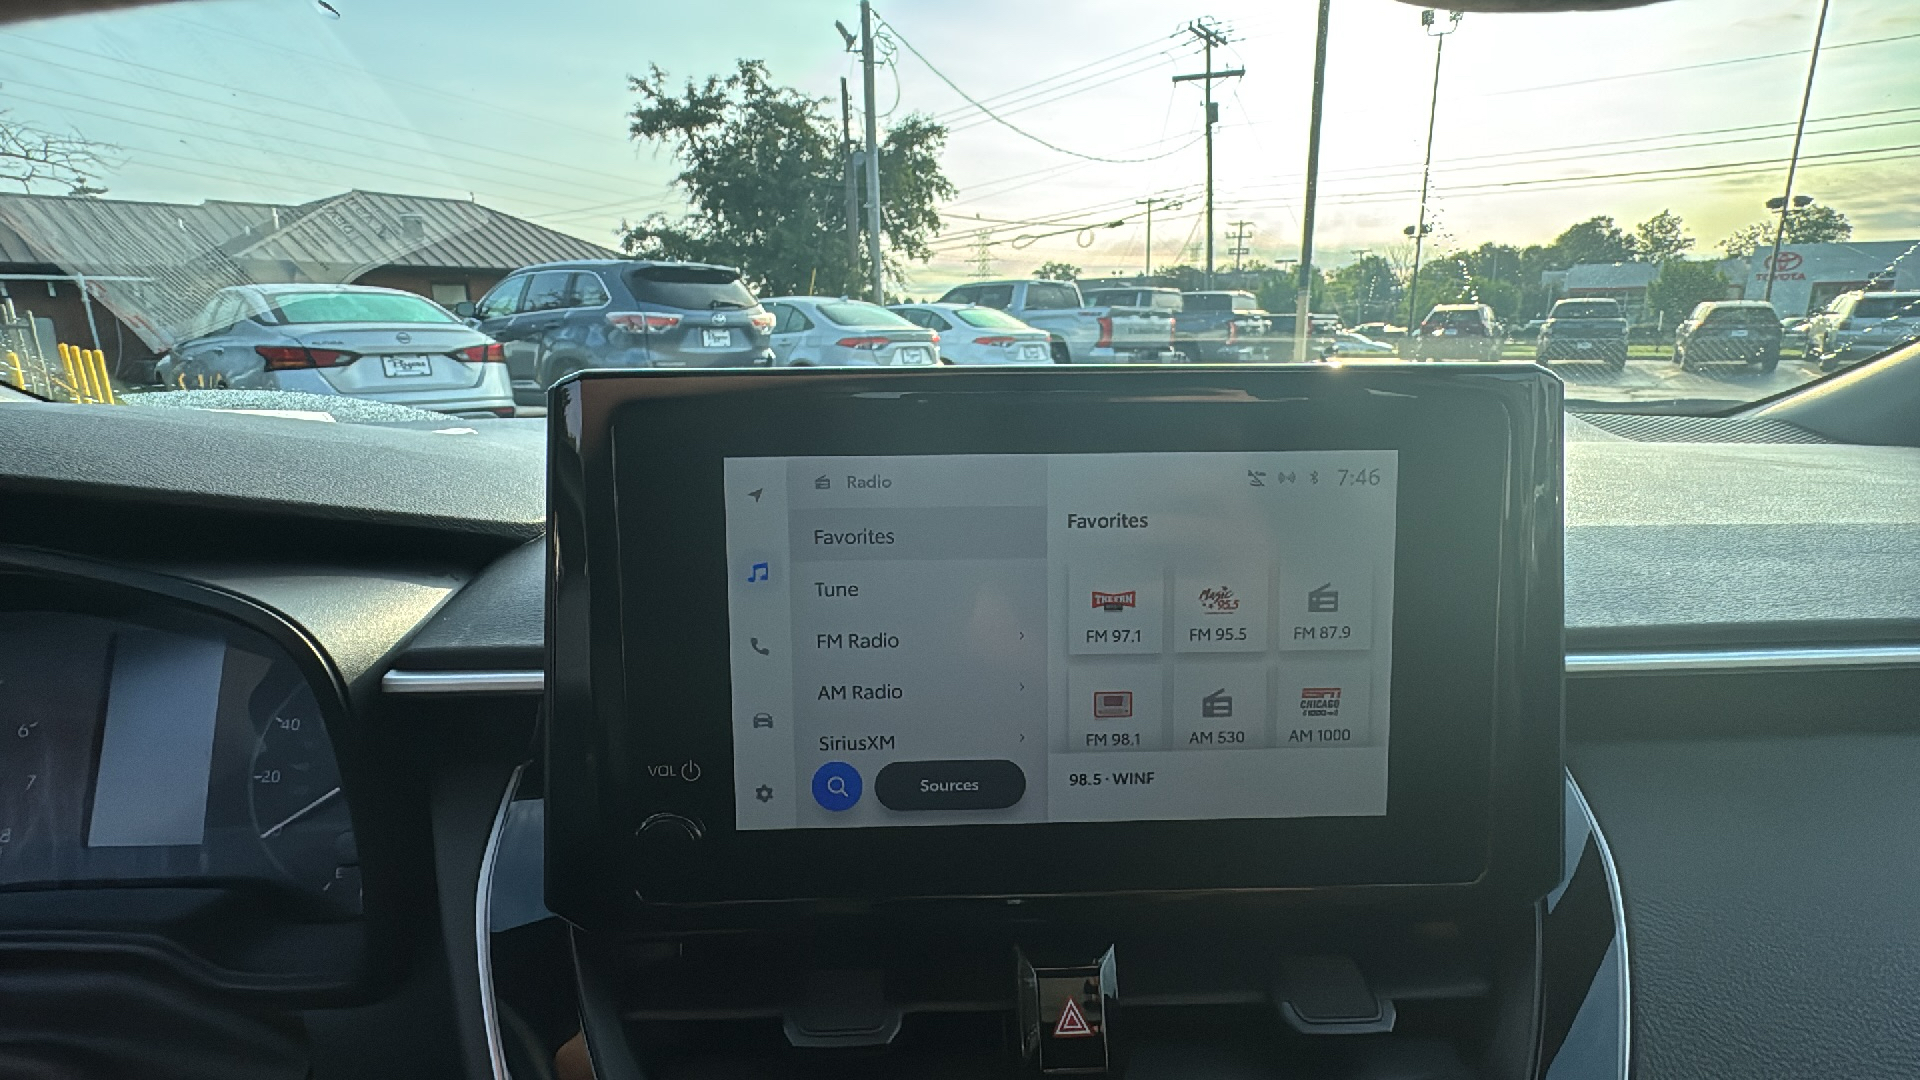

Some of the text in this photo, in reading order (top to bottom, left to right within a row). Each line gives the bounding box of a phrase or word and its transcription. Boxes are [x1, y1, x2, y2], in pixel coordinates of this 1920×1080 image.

[1755, 273, 1806, 281] TOYOTA
[846, 474, 893, 489] Radio
[1337, 468, 1381, 487] 7:46
[1067, 512, 1149, 529] Favorites
[814, 527, 895, 545] Favorites
[814, 582, 859, 598] Tune
[1086, 629, 1141, 643] FM 97.1
[1189, 627, 1247, 642] FM 95.5
[1293, 625, 1351, 640] FM 87.9
[817, 632, 900, 649] FM Radio
[817, 683, 903, 701] AM Radio
[1300, 699, 1340, 708] CHICAGO
[18, 723, 29, 738] 6
[280, 718, 301, 731] 40
[1086, 733, 1140, 747] FM 98.1
[1189, 730, 1245, 745] AM 530
[1288, 728, 1351, 743] AM 1000
[819, 735, 895, 752] SiriusXM
[261, 770, 281, 783] 20
[647, 765, 677, 777] VOL
[1112, 771, 1155, 785] WINF
[26, 774, 37, 791] 7
[920, 779, 979, 793] Sources
